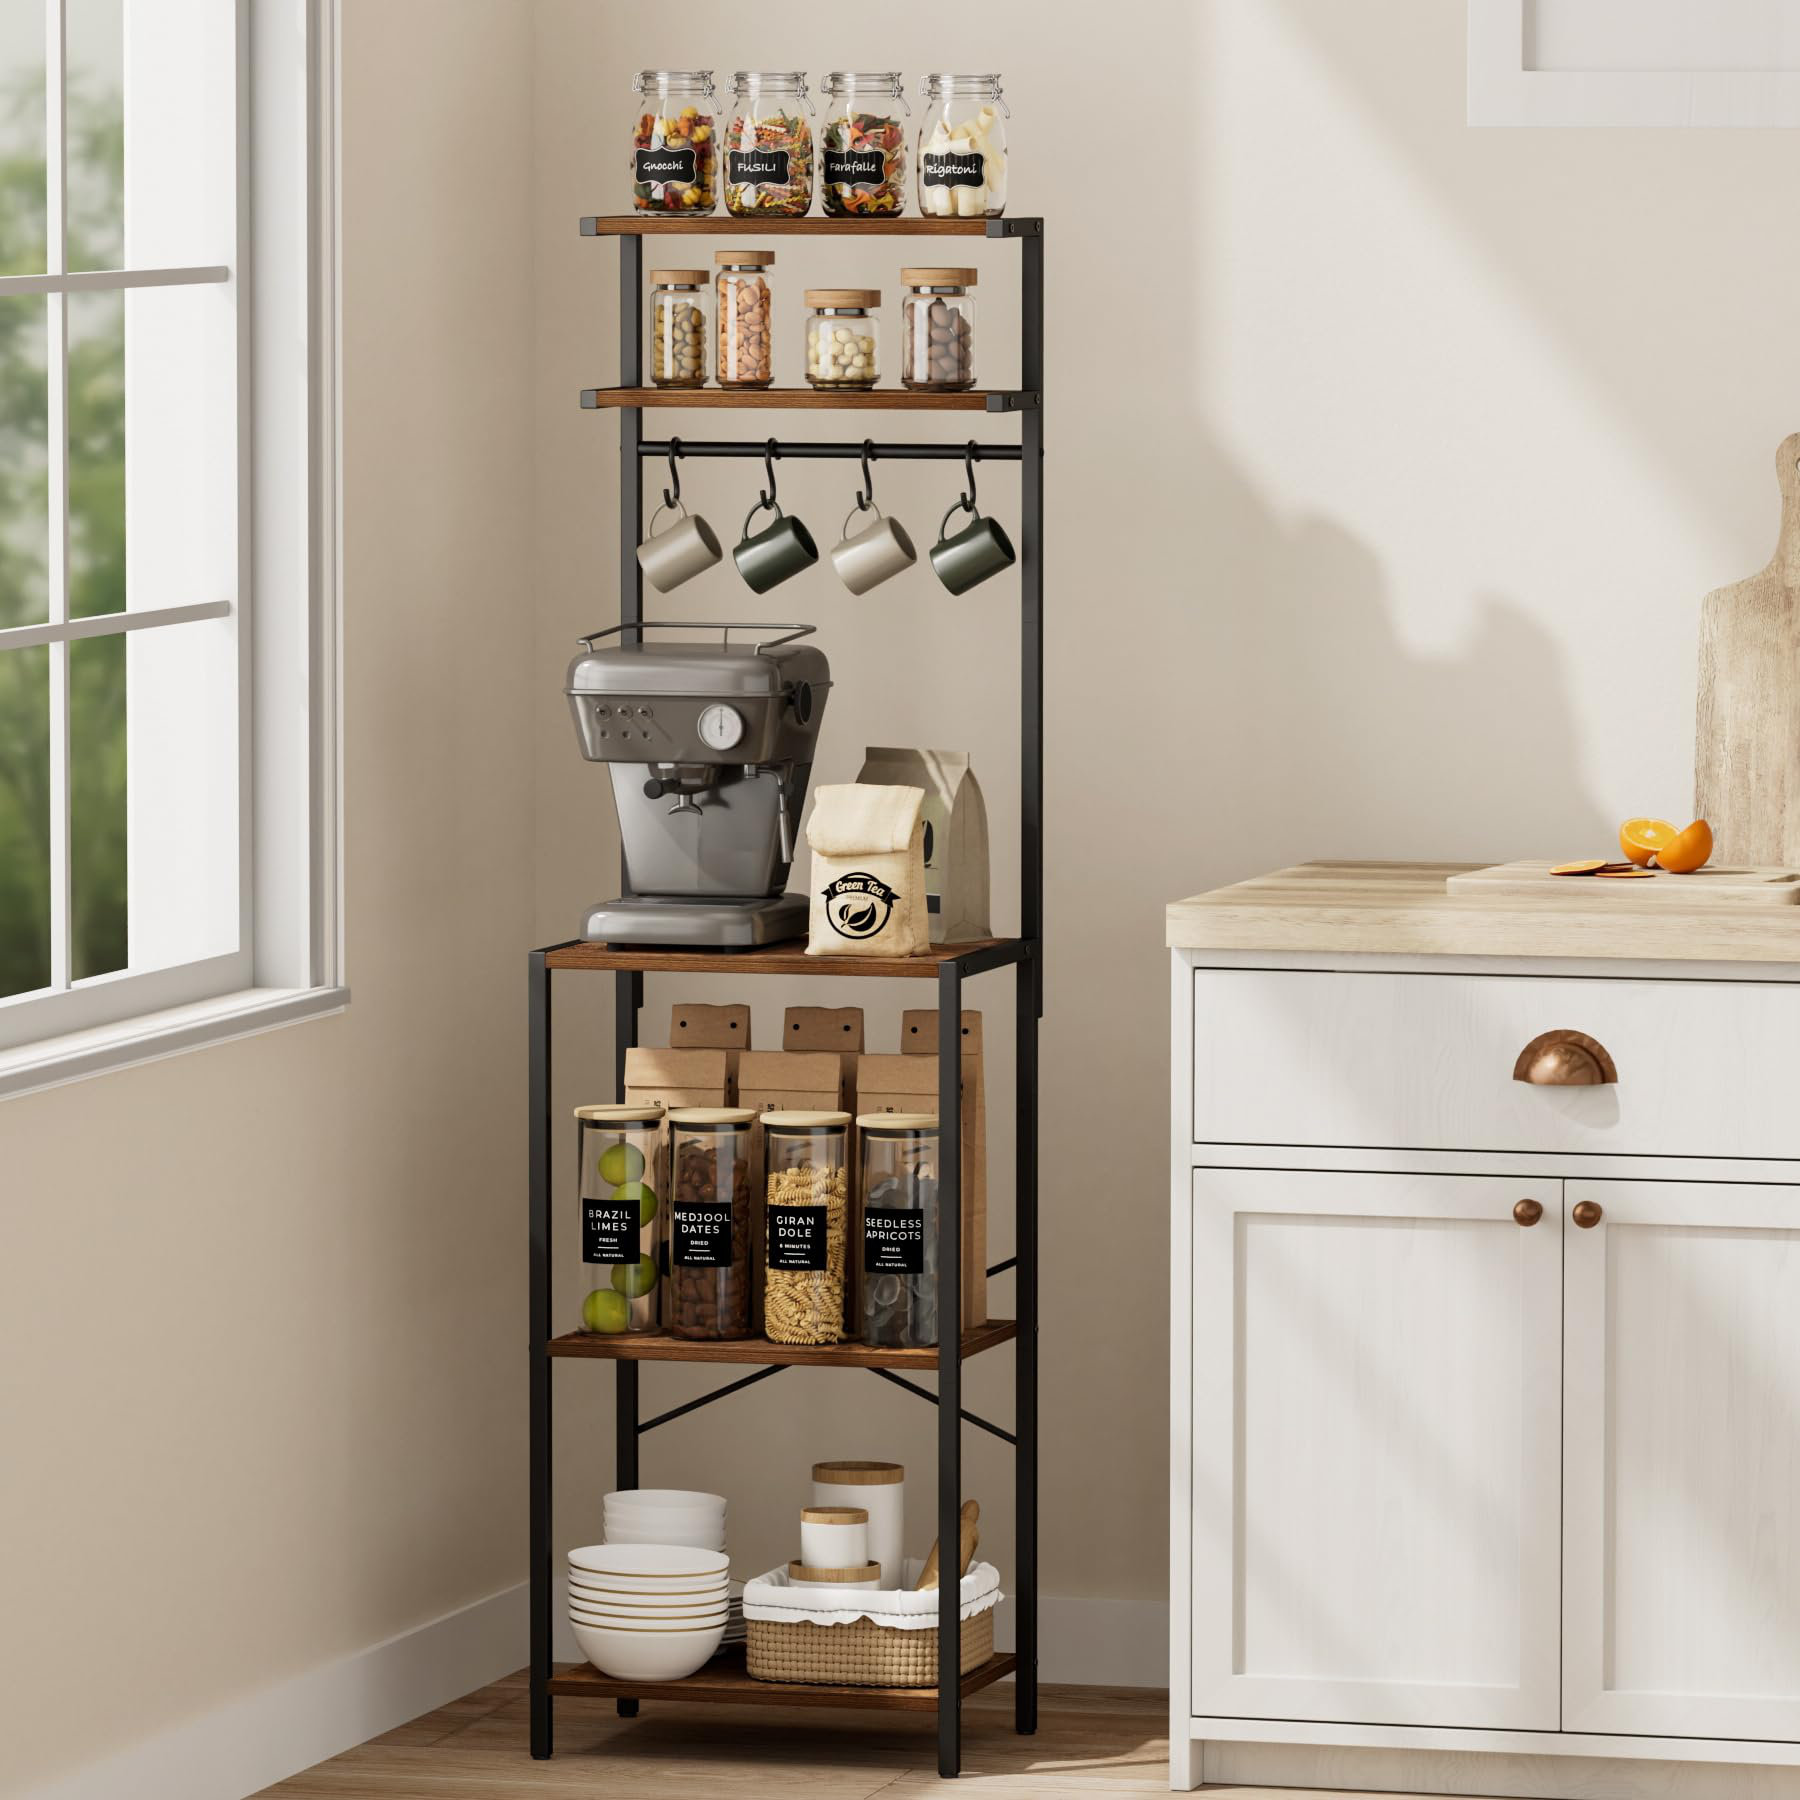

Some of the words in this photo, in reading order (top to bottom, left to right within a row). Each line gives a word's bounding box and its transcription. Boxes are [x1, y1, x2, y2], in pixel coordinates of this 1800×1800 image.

[642, 160, 684, 171] Gnocchi
[829, 161, 877, 174] Farafalle
[926, 163, 977, 177] Rigatoni
[835, 880, 864, 893] Green
[867, 880, 885, 897] Tea
[588, 1209, 632, 1220] BRAZIL
[674, 1211, 731, 1222] MEDJOOL
[776, 1215, 815, 1225] GIRAN
[591, 1222, 628, 1231] LIMES
[865, 1217, 922, 1229] SEEDLESS
[681, 1224, 720, 1234] DATES
[778, 1227, 812, 1238] DOLE
[866, 1230, 921, 1241] APRICOTS
